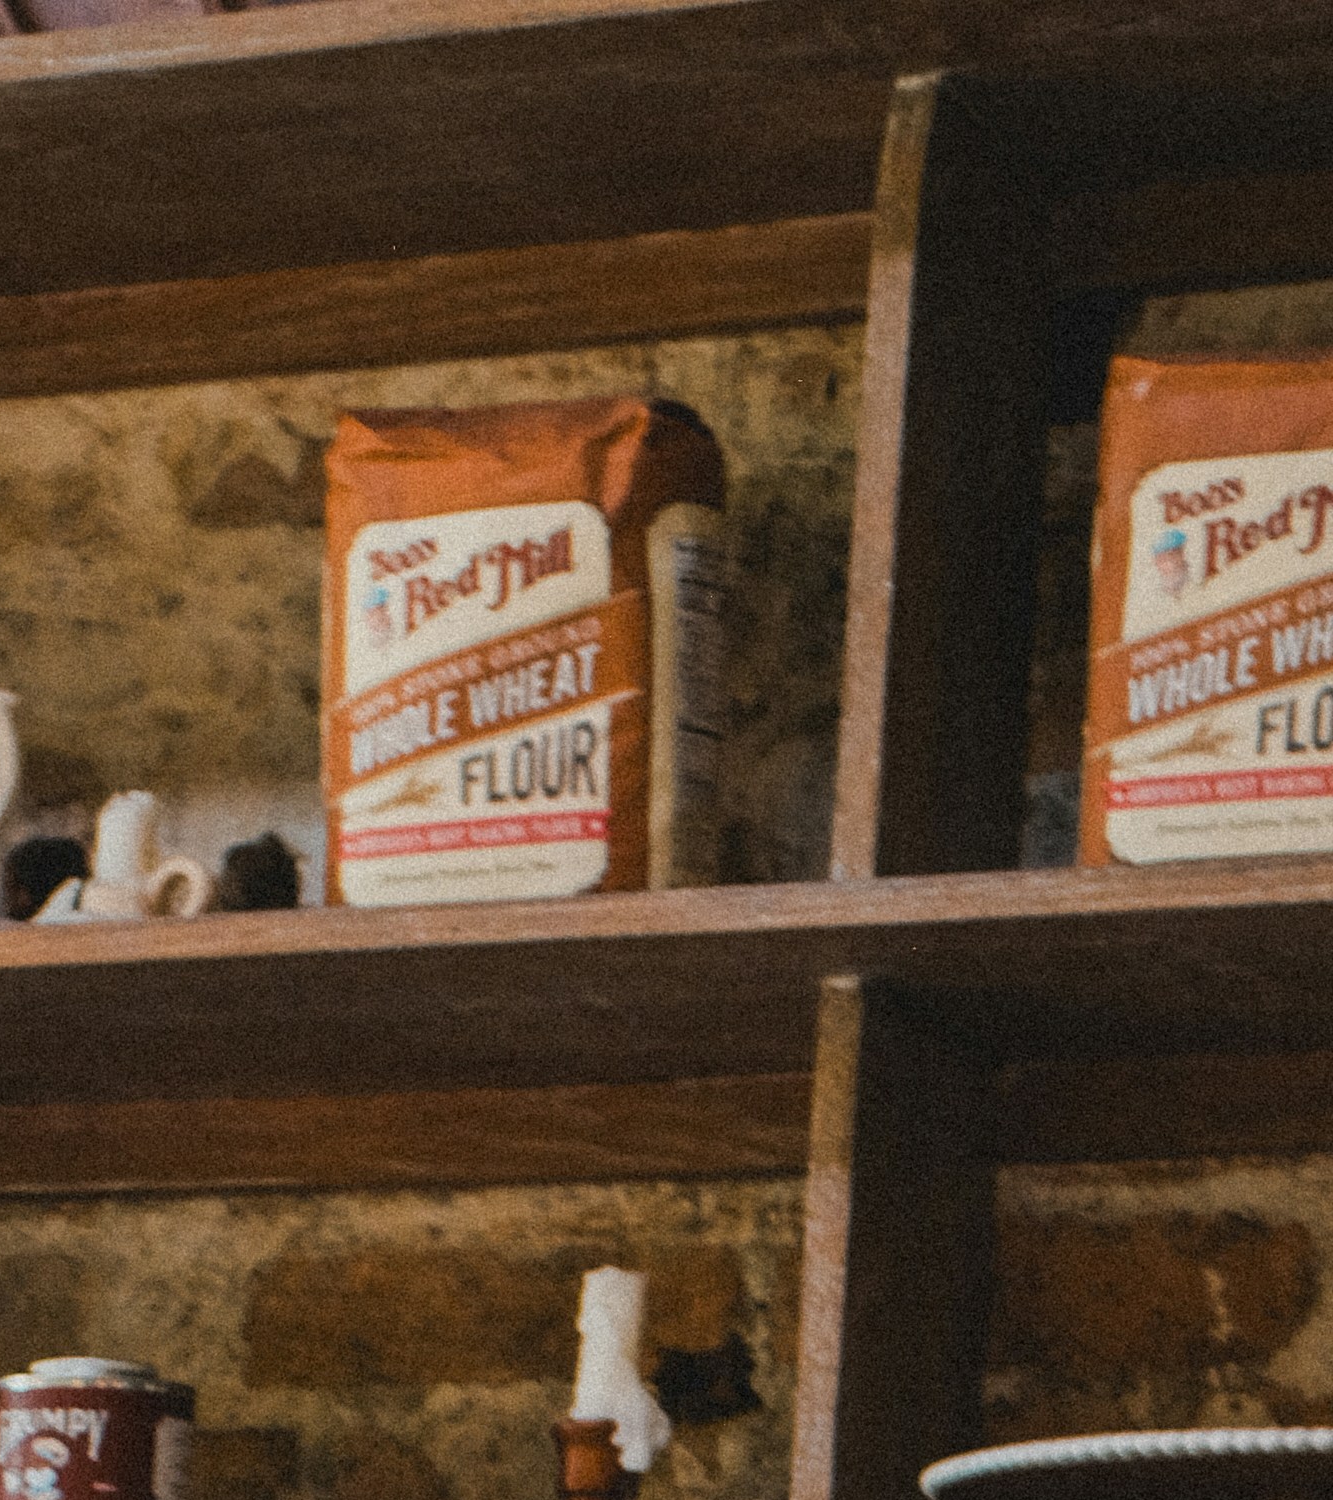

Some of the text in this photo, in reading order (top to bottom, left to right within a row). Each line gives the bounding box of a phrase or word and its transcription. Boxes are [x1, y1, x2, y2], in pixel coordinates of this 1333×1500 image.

[1202, 495, 1294, 586] Red
[404, 553, 483, 637] Red
[468, 641, 603, 728] WHEAT
[1127, 636, 1262, 725] WHOLE
[458, 719, 598, 807] FLOUR
